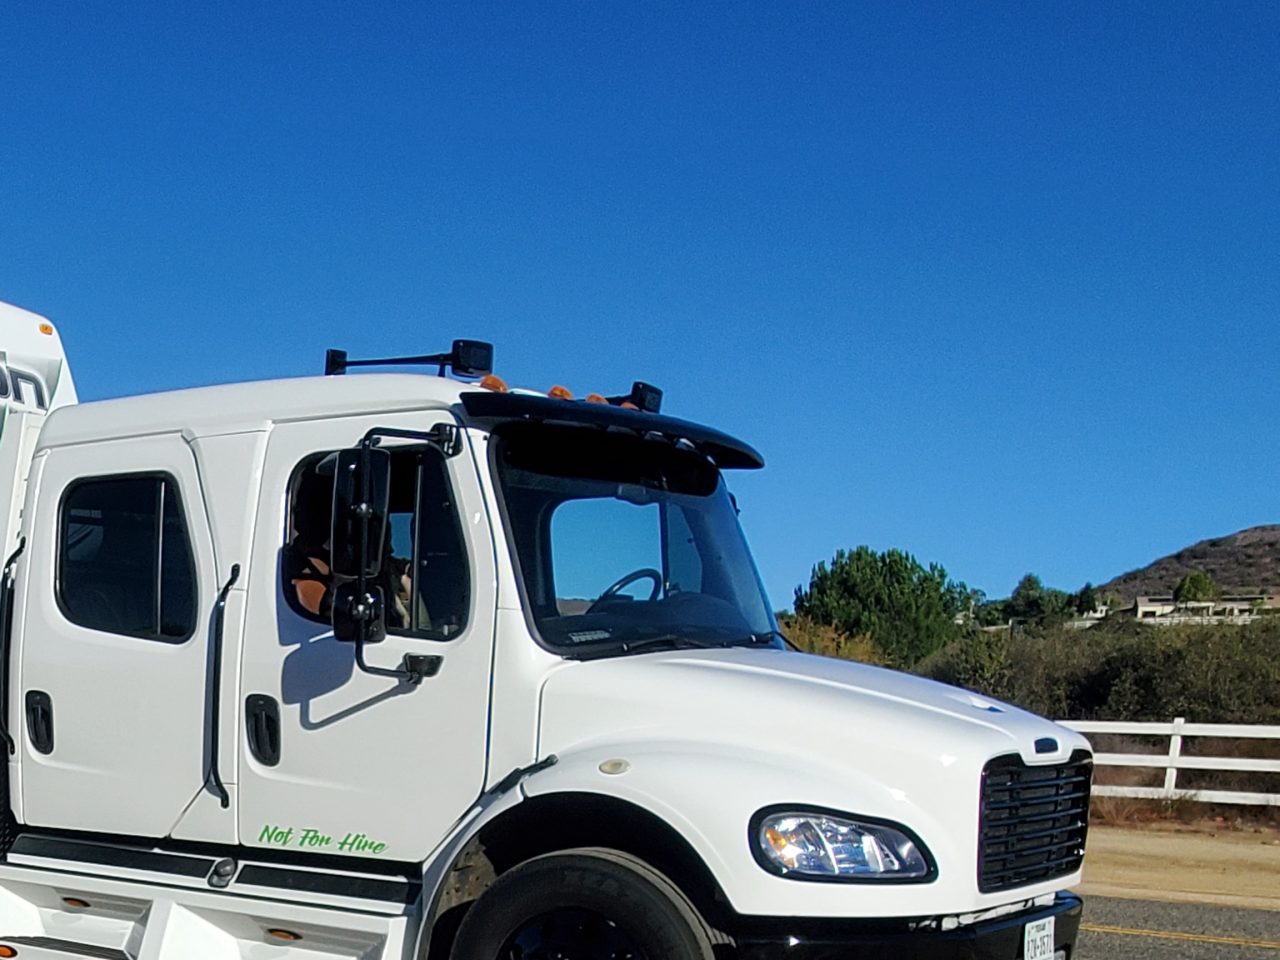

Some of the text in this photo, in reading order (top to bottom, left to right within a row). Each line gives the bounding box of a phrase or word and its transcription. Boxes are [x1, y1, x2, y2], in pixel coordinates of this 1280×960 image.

[258, 825, 389, 854] Not For Hire
